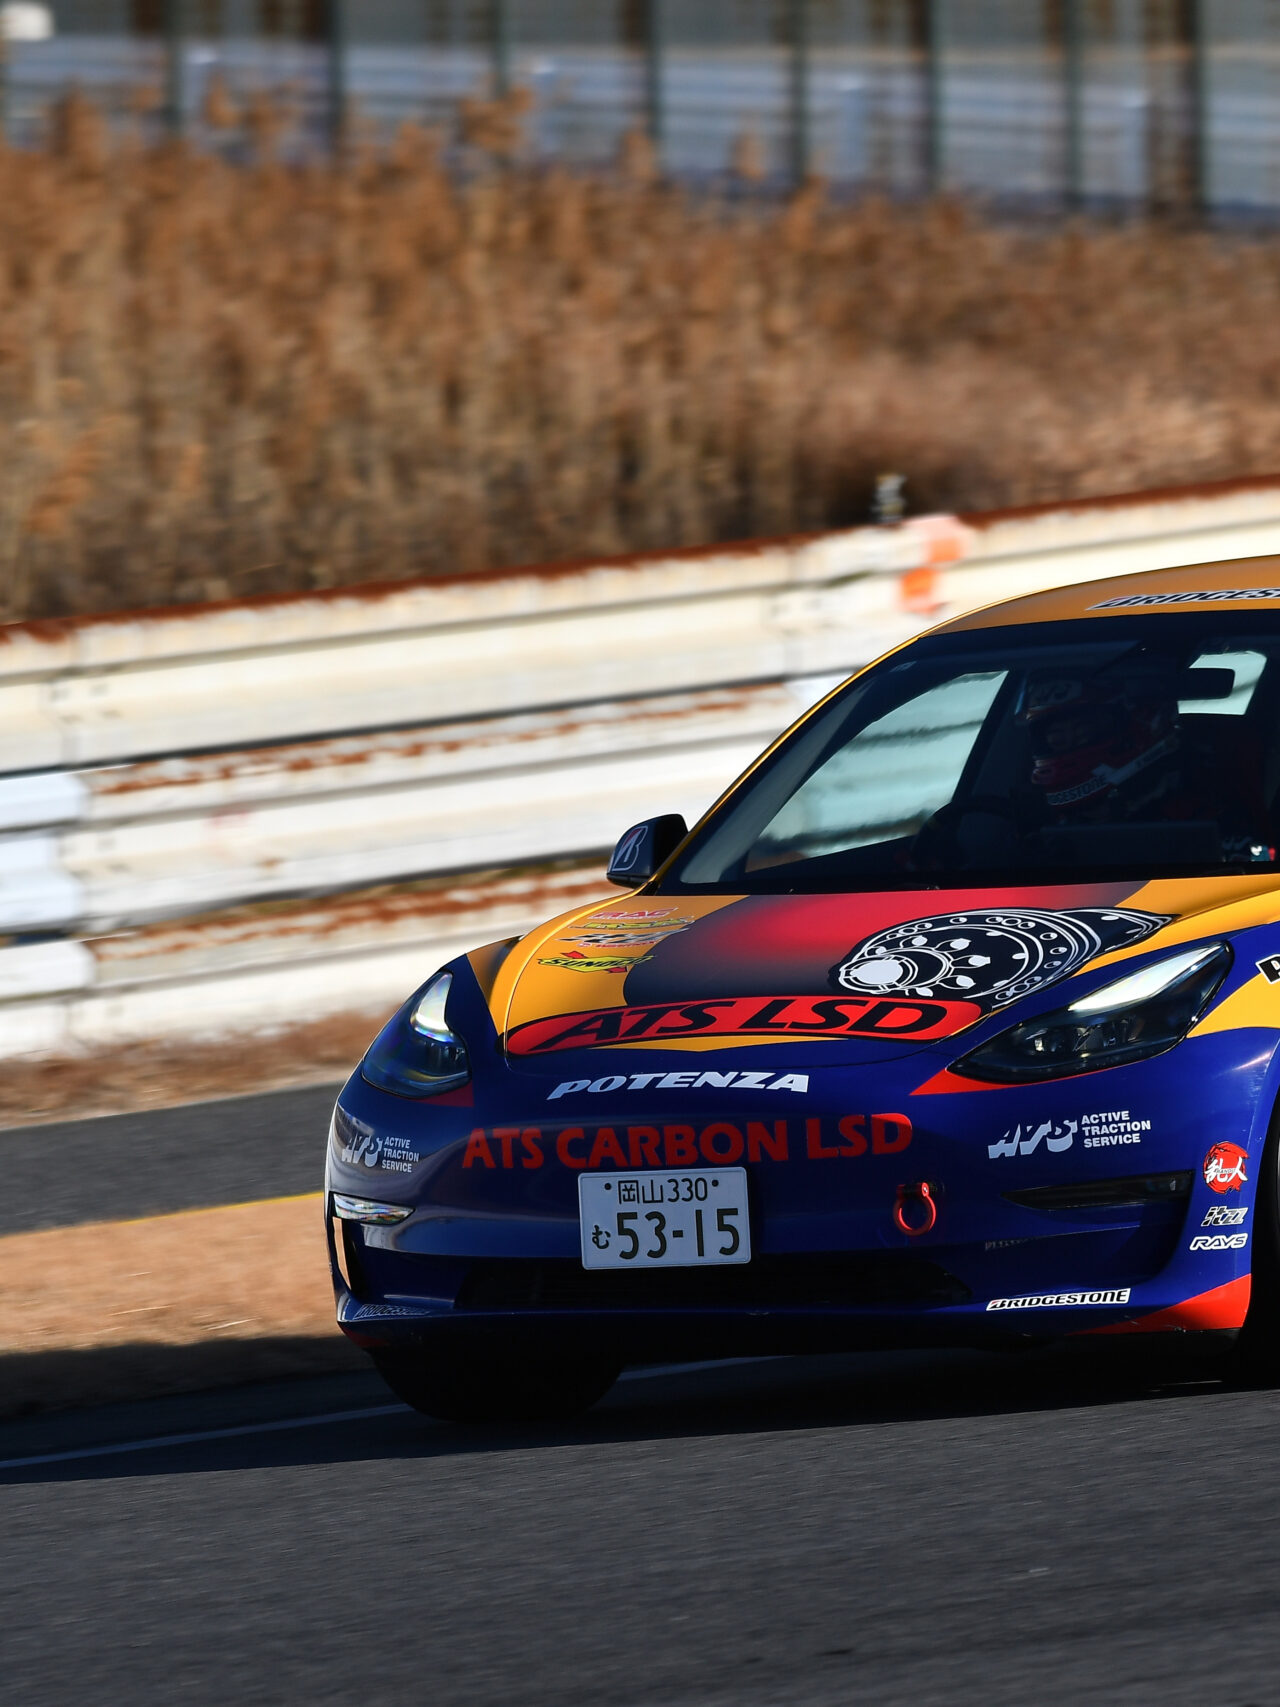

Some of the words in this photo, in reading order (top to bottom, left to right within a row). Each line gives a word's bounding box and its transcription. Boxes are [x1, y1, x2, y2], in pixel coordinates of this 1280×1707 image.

[527, 1001, 736, 1053] ATS
[738, 999, 948, 1035] LSD
[547, 1071, 810, 1101] POTENZA
[1081, 1110, 1130, 1125] ACTIVE
[1082, 1120, 1152, 1137] TRACTION
[384, 1136, 411, 1149] ACTIVE
[462, 1128, 545, 1170] ATS
[556, 1120, 789, 1169] CARBON
[805, 1113, 913, 1160] LSD
[1084, 1133, 1141, 1149] SERVICE
[382, 1147, 420, 1163] TRACTION
[381, 1159, 412, 1173] SERVICE
[591, 1224, 612, 1250] む
[616, 1207, 740, 1260] 53-15
[1191, 1234, 1248, 1250] RAYS
[988, 1289, 1129, 1310] BRIDGESTONE
